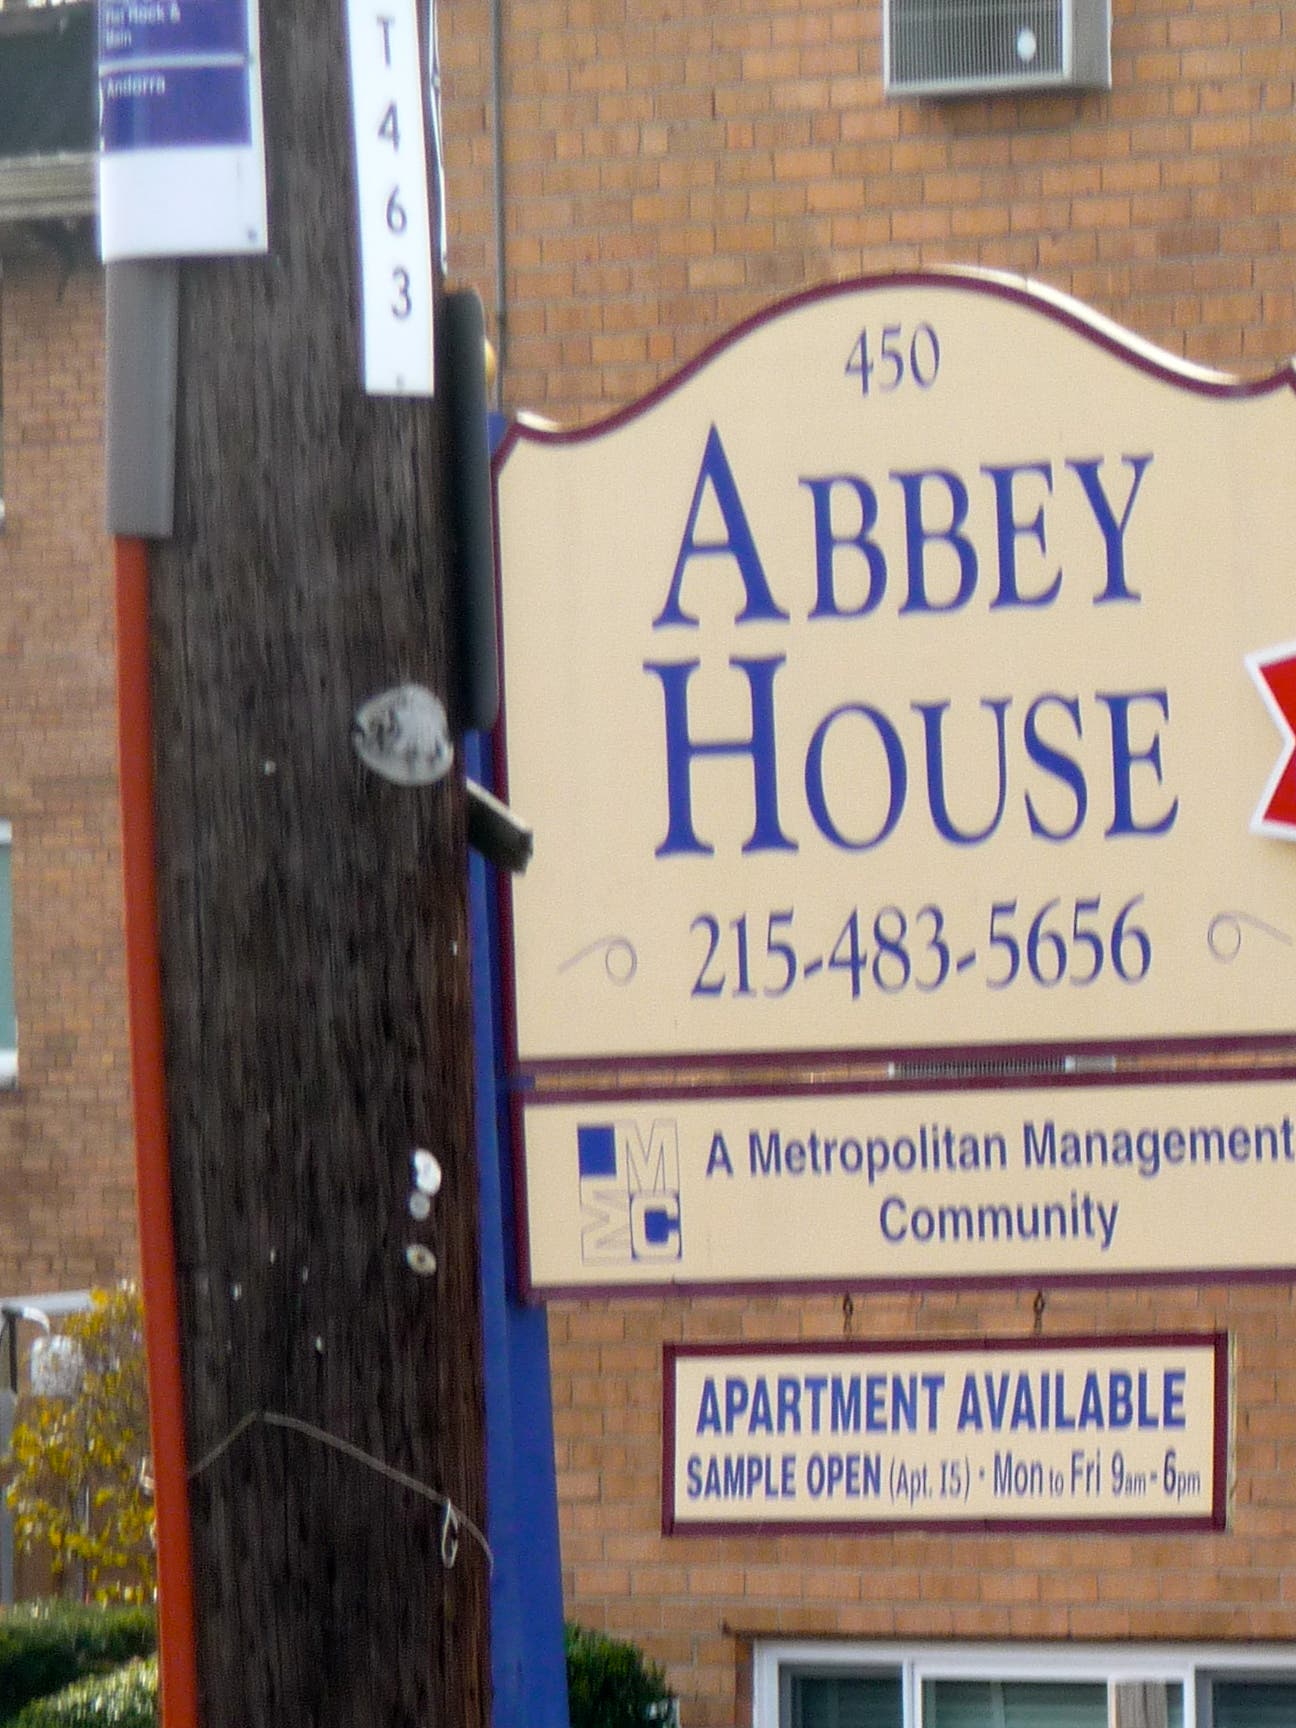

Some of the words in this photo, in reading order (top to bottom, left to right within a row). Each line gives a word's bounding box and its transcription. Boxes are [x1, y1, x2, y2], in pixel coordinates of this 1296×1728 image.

[843, 321, 942, 398] 450
[652, 421, 1155, 630] ABBEY
[642, 650, 1181, 860] HOUSE
[690, 893, 1154, 1001] 215-483-5656
[705, 1127, 735, 1179] A
[748, 1121, 1008, 1187] Metropolitan
[1022, 1113, 1296, 1180] Management
[879, 1188, 1119, 1251] Community
[695, 1372, 946, 1438] APARTMENT
[957, 1366, 1187, 1434] AVAILABLE
[686, 1451, 797, 1500] SAMPLE
[806, 1450, 882, 1500] OPEN
[993, 1448, 1044, 1498] Mon
[1049, 1464, 1065, 1497] to
[1070, 1447, 1102, 1497] Fri
